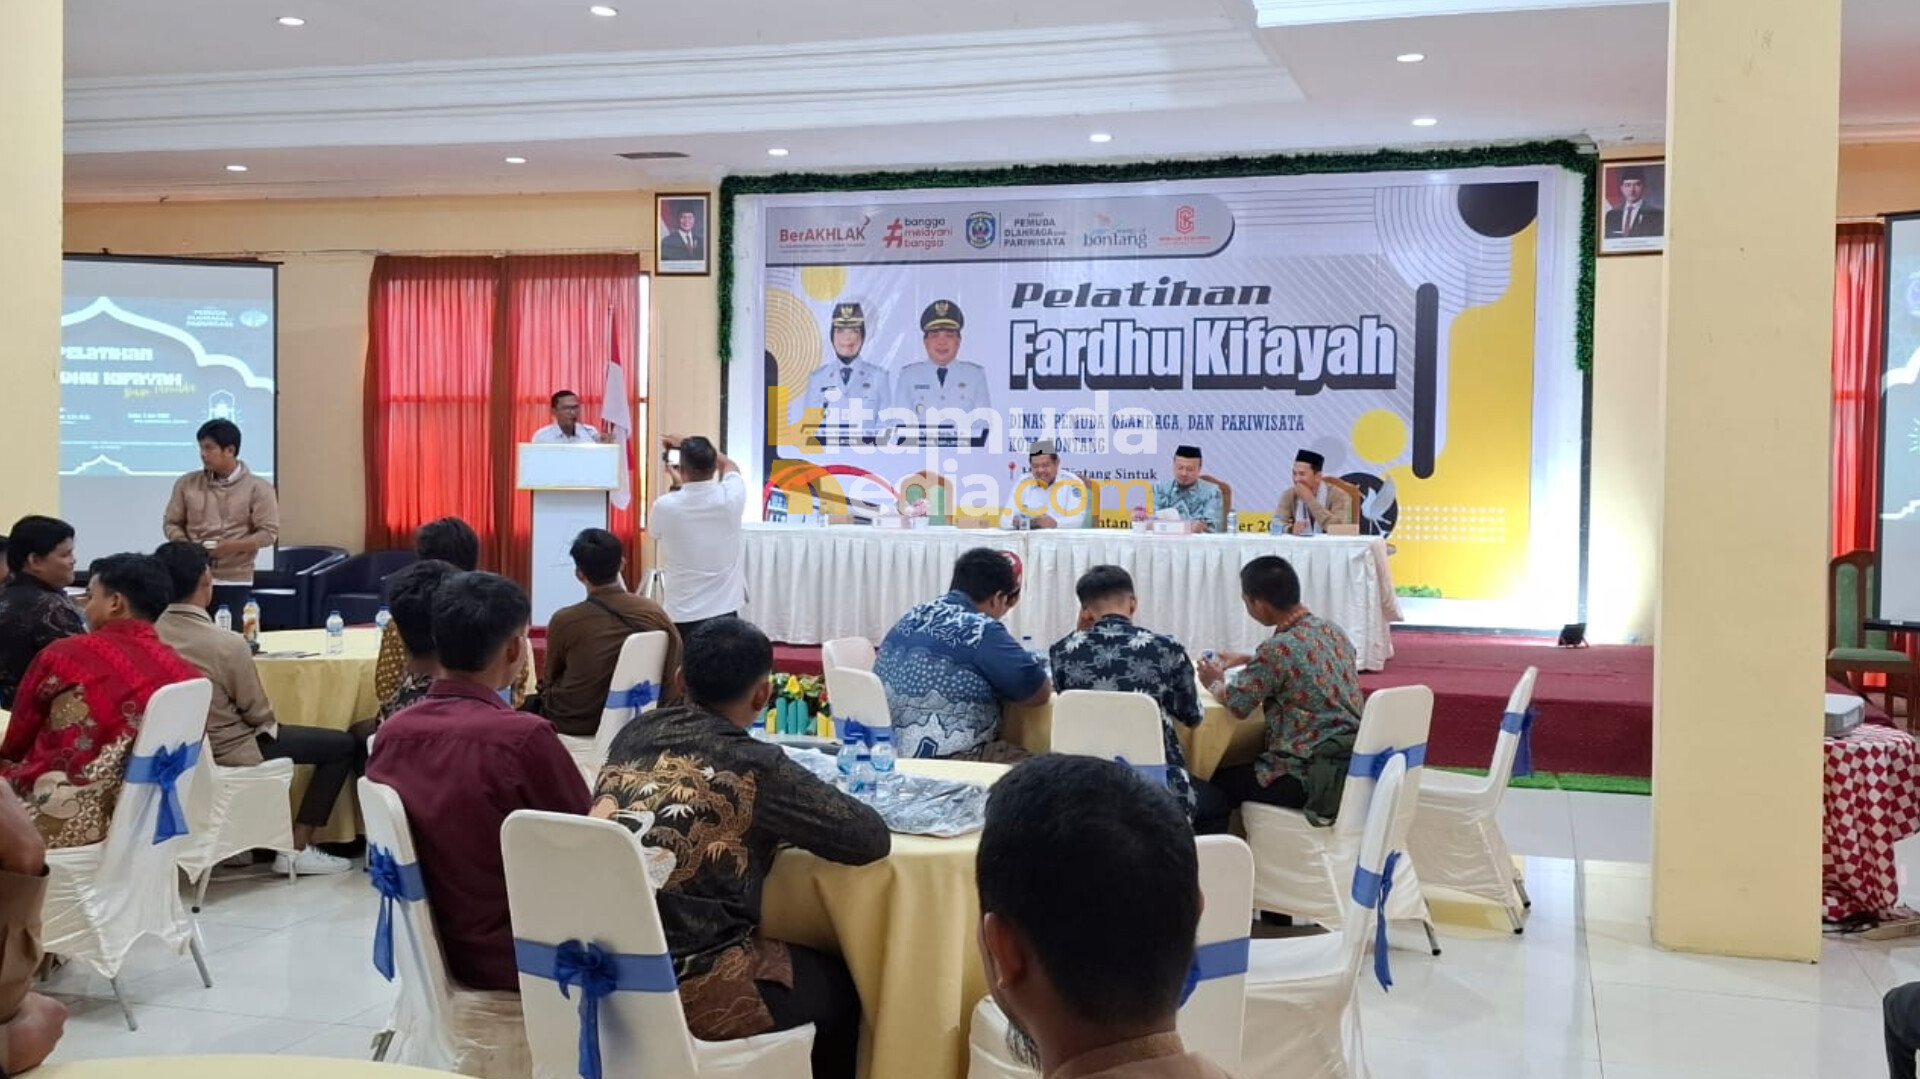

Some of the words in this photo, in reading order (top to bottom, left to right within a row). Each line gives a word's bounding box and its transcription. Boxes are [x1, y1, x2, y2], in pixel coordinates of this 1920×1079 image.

[904, 217, 946, 229] bangga
[1014, 218, 1056, 228] PEMUDA
[780, 226, 866, 243] BerAKHLAK
[904, 226, 953, 241] melayani
[904, 238, 945, 250] bangsa
[1004, 237, 1067, 248] PARIWISATA
[1011, 276, 1271, 309] Pelatihan
[1010, 318, 1184, 390] Fardhu
[1192, 315, 1398, 396] Kifayah
[1009, 413, 1046, 430] DINAS
[1054, 413, 1105, 430] PEMUDA
[1188, 414, 1214, 431] DAN
[1222, 414, 1305, 431] PARIWISATA
[1048, 436, 1105, 453] ONTANG
[1115, 467, 1158, 481] Sintuk
